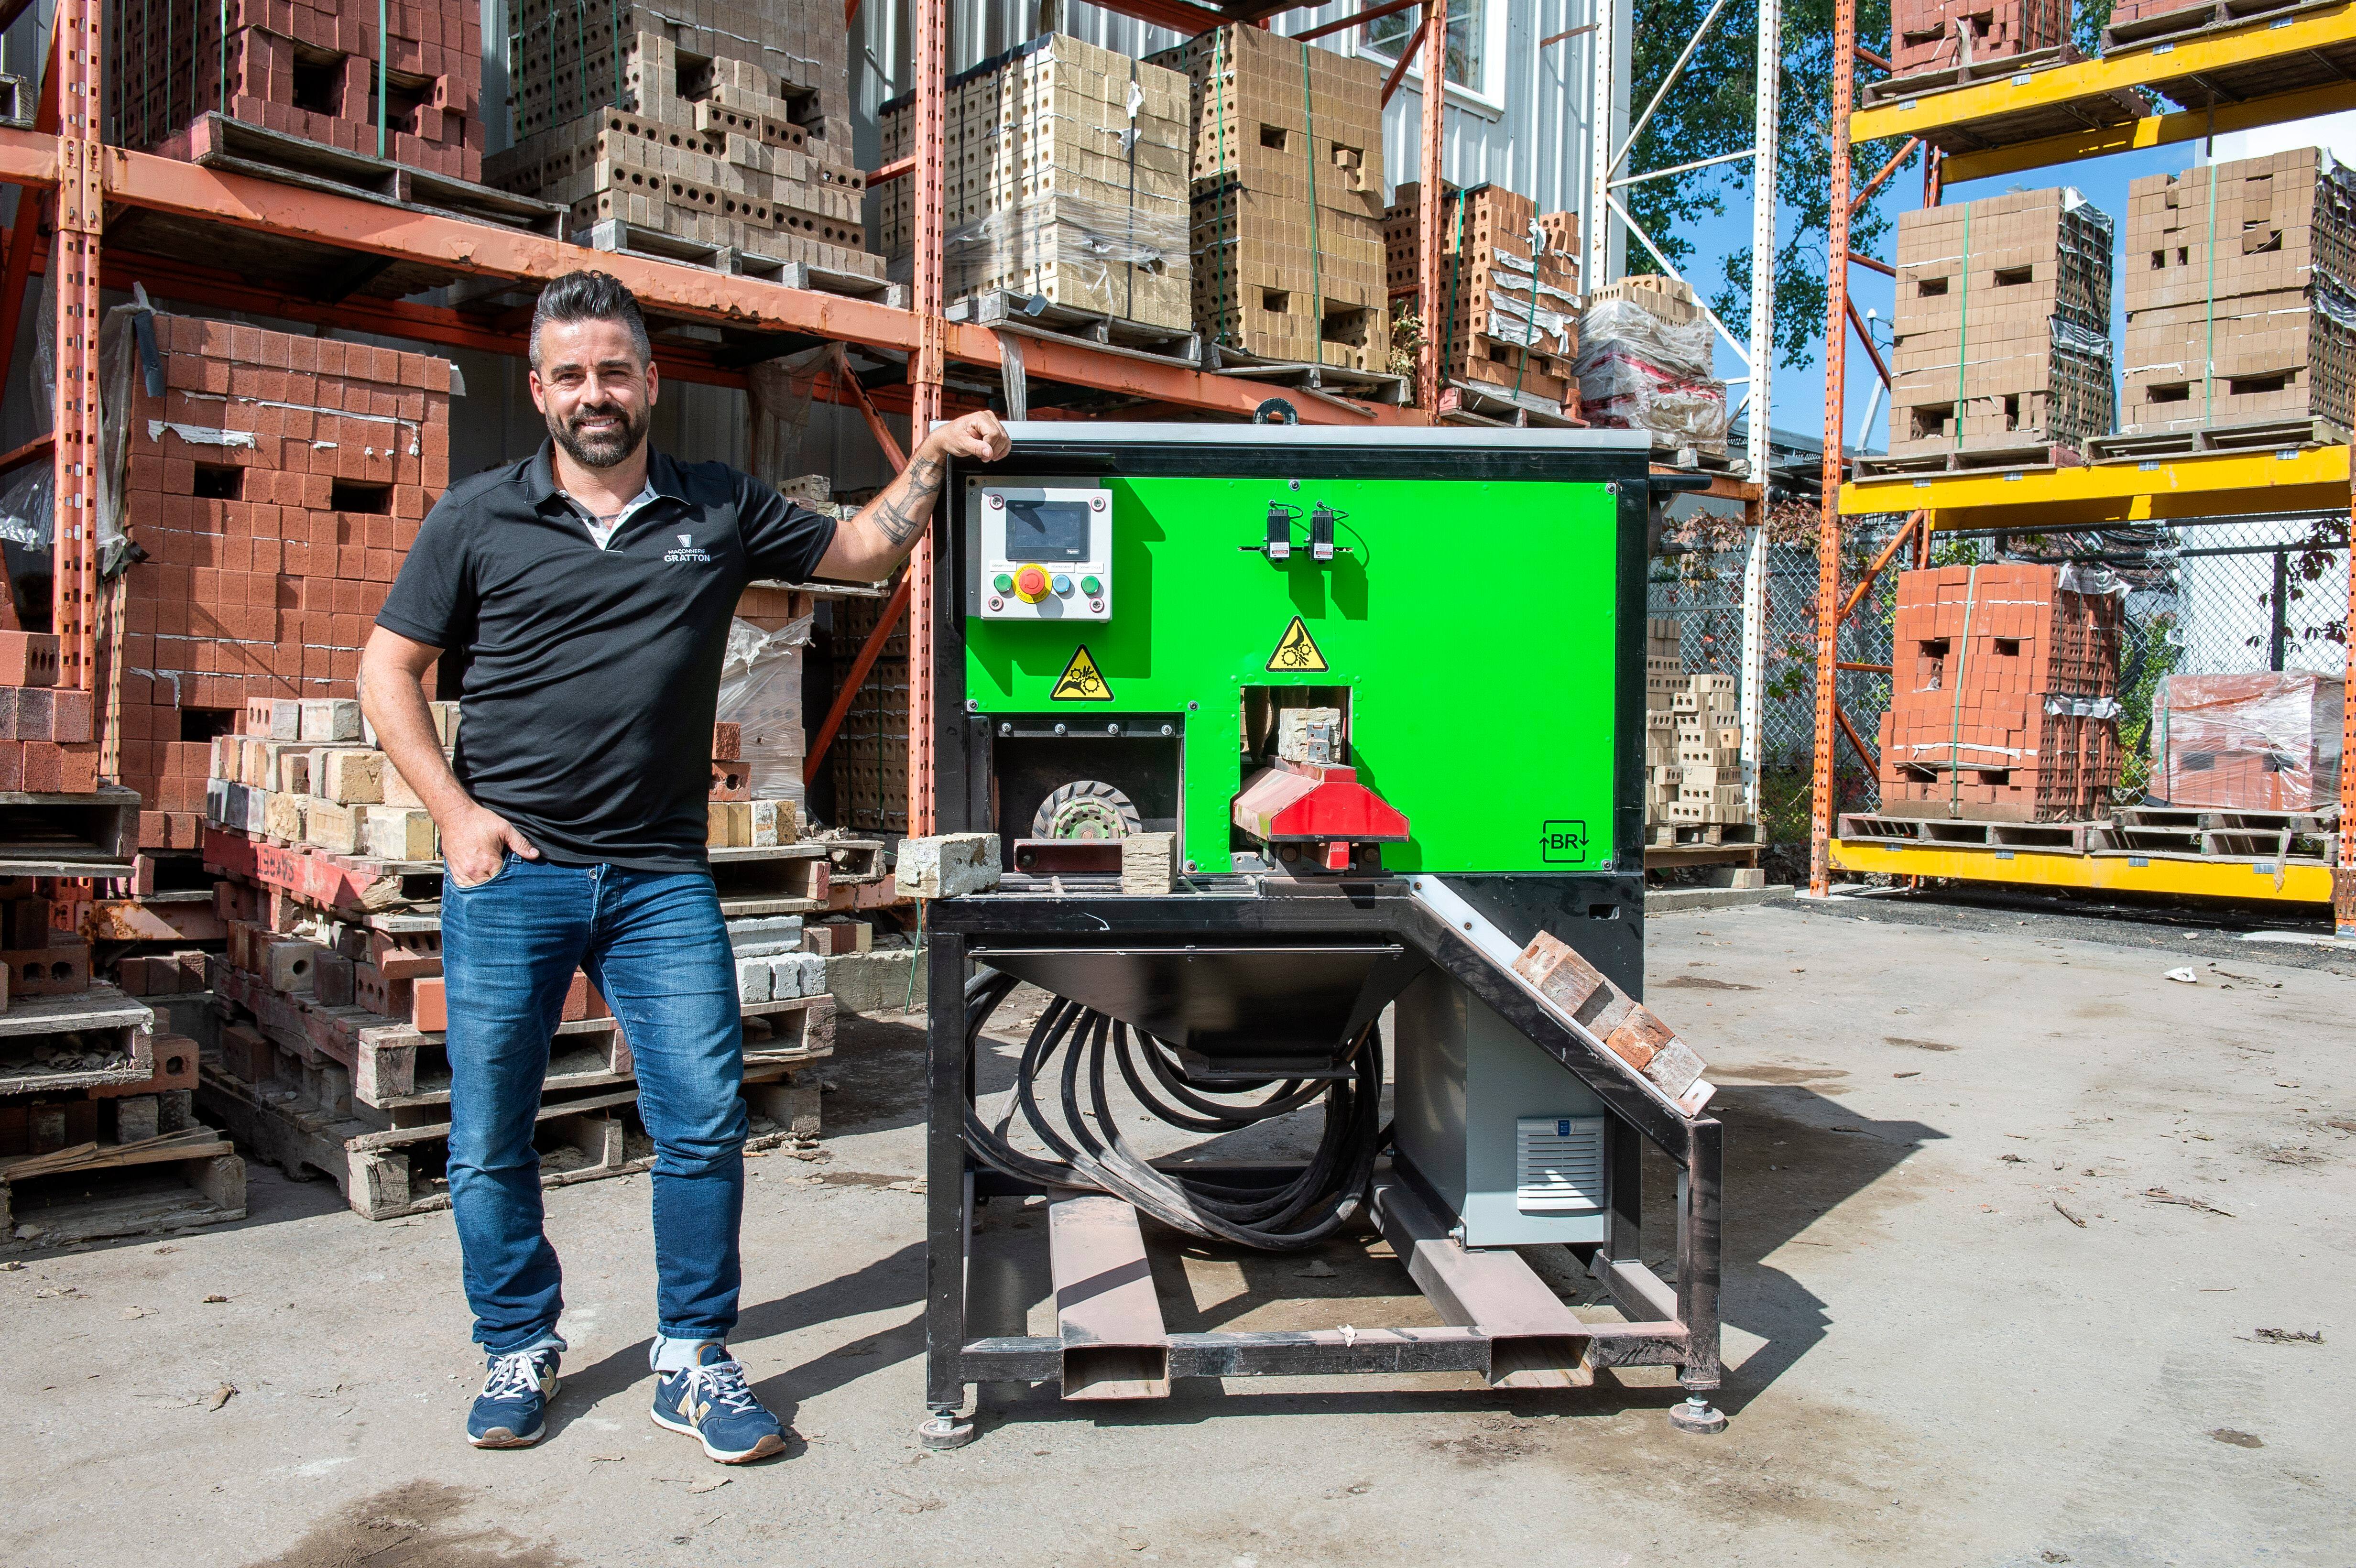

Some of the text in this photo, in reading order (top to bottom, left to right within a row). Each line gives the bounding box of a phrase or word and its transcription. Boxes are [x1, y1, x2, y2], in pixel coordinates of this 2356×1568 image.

[664, 554, 711, 562] GRATTON
[1017, 590, 1048, 601] EMERGENCY STOP
[1551, 834, 1579, 849] BR
